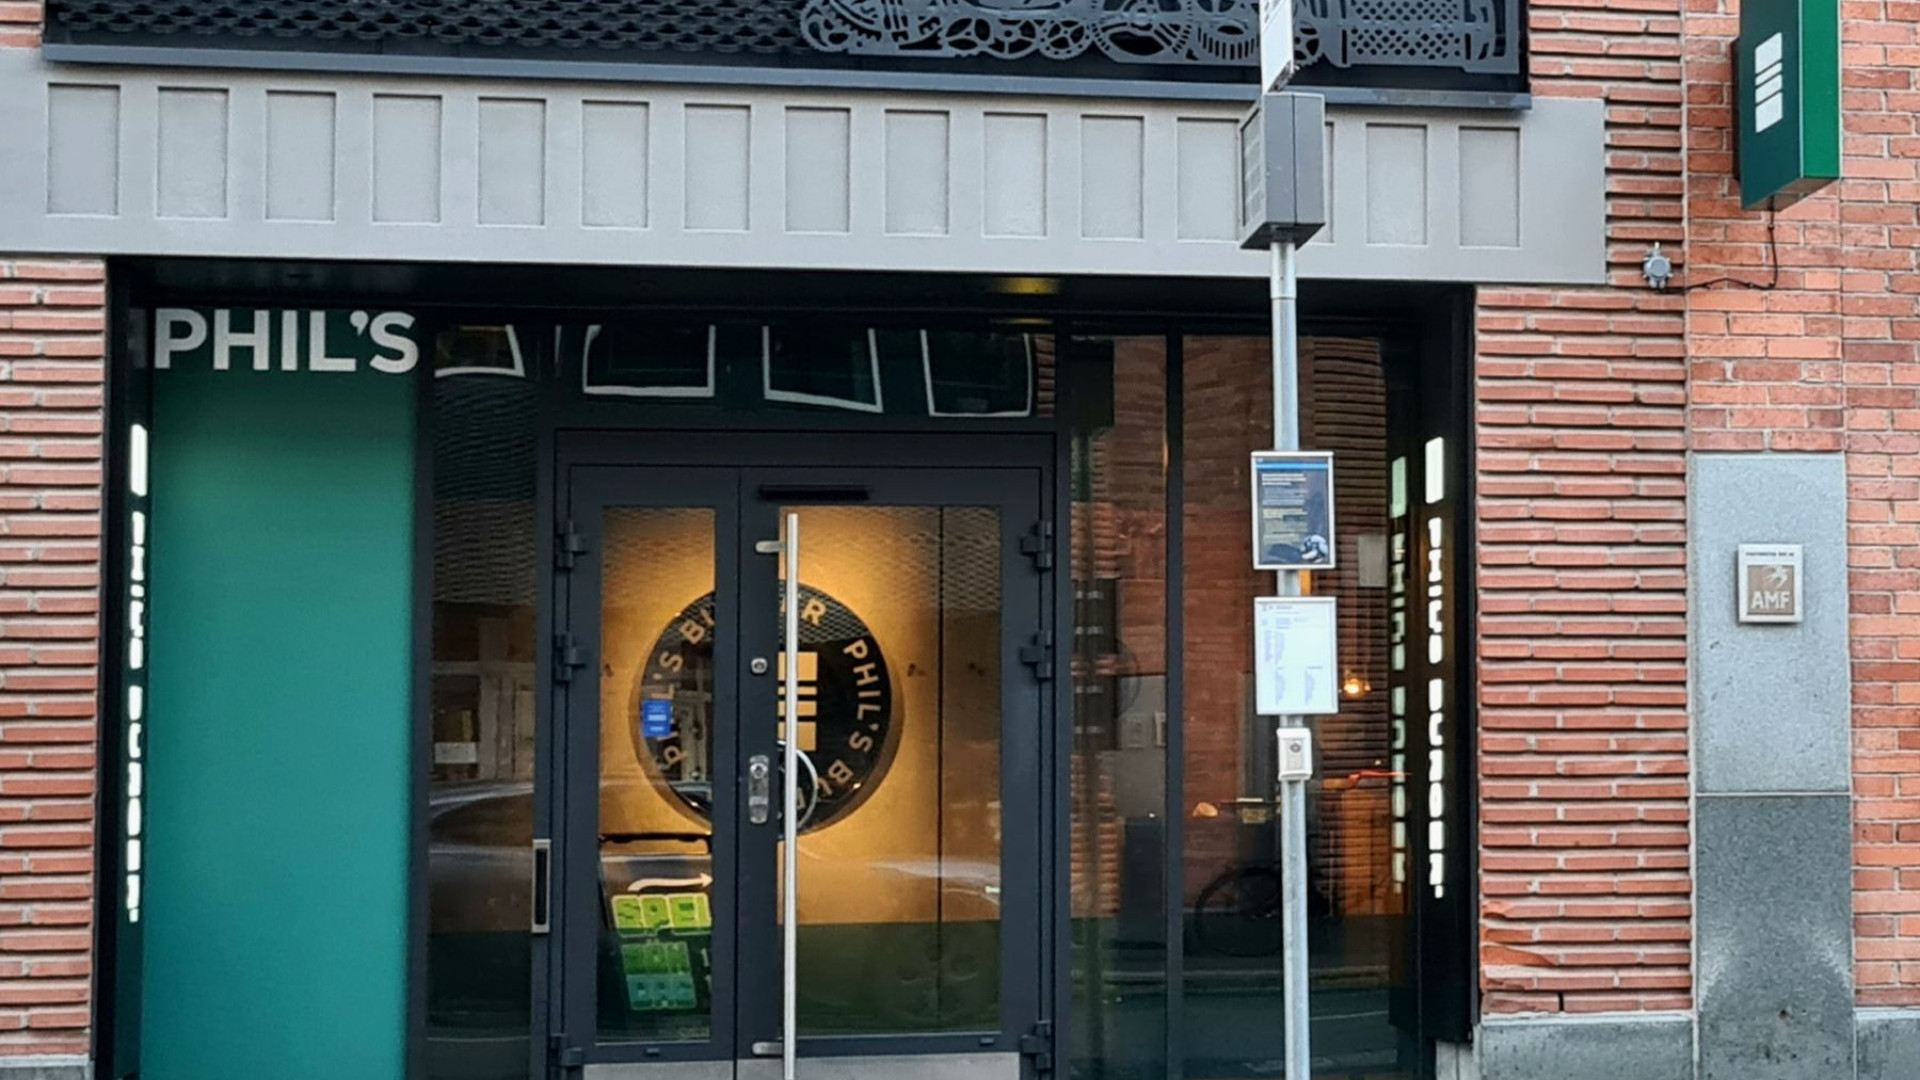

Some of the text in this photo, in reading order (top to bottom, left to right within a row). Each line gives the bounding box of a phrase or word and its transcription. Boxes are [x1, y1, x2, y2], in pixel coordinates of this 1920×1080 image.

[154, 308, 419, 374] PHIL'S
[1751, 590, 1791, 609] AMF
[651, 651, 688, 765] PL'S
[842, 639, 881, 752] PHIL'S
